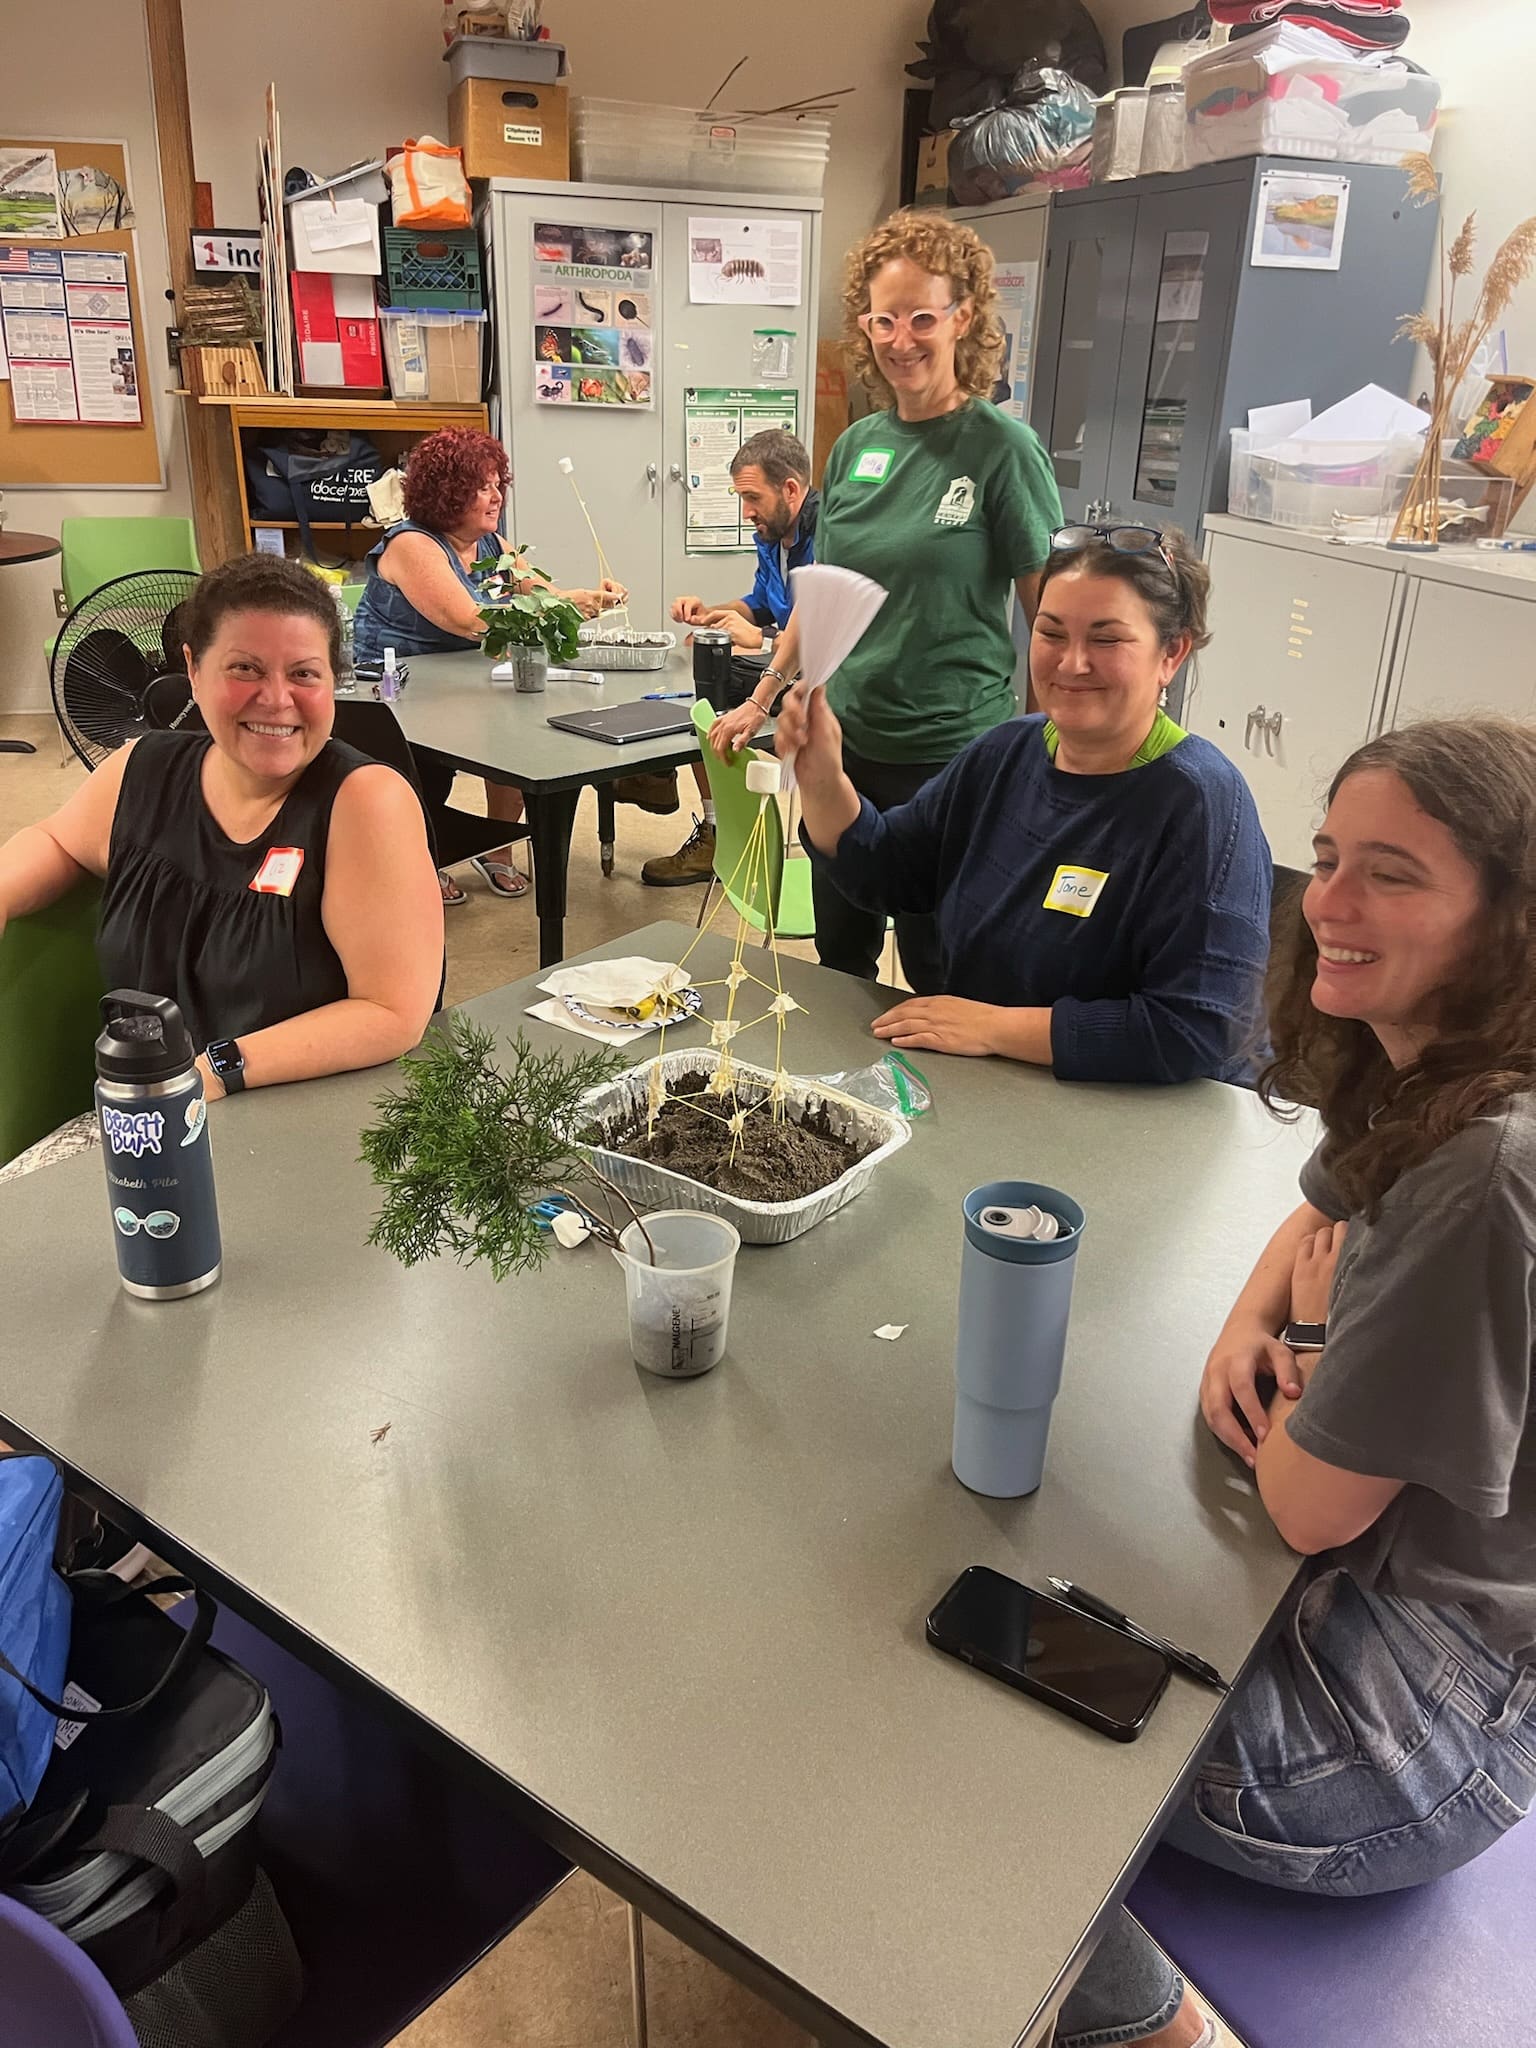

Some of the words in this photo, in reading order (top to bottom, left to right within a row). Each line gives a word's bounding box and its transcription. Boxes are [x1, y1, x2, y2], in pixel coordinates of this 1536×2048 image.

[203, 241, 219, 266] 1
[554, 264, 633, 281] ARTHROPODA
[1057, 876, 1093, 898] Jane
[671, 1308, 681, 1349] NALGENE
